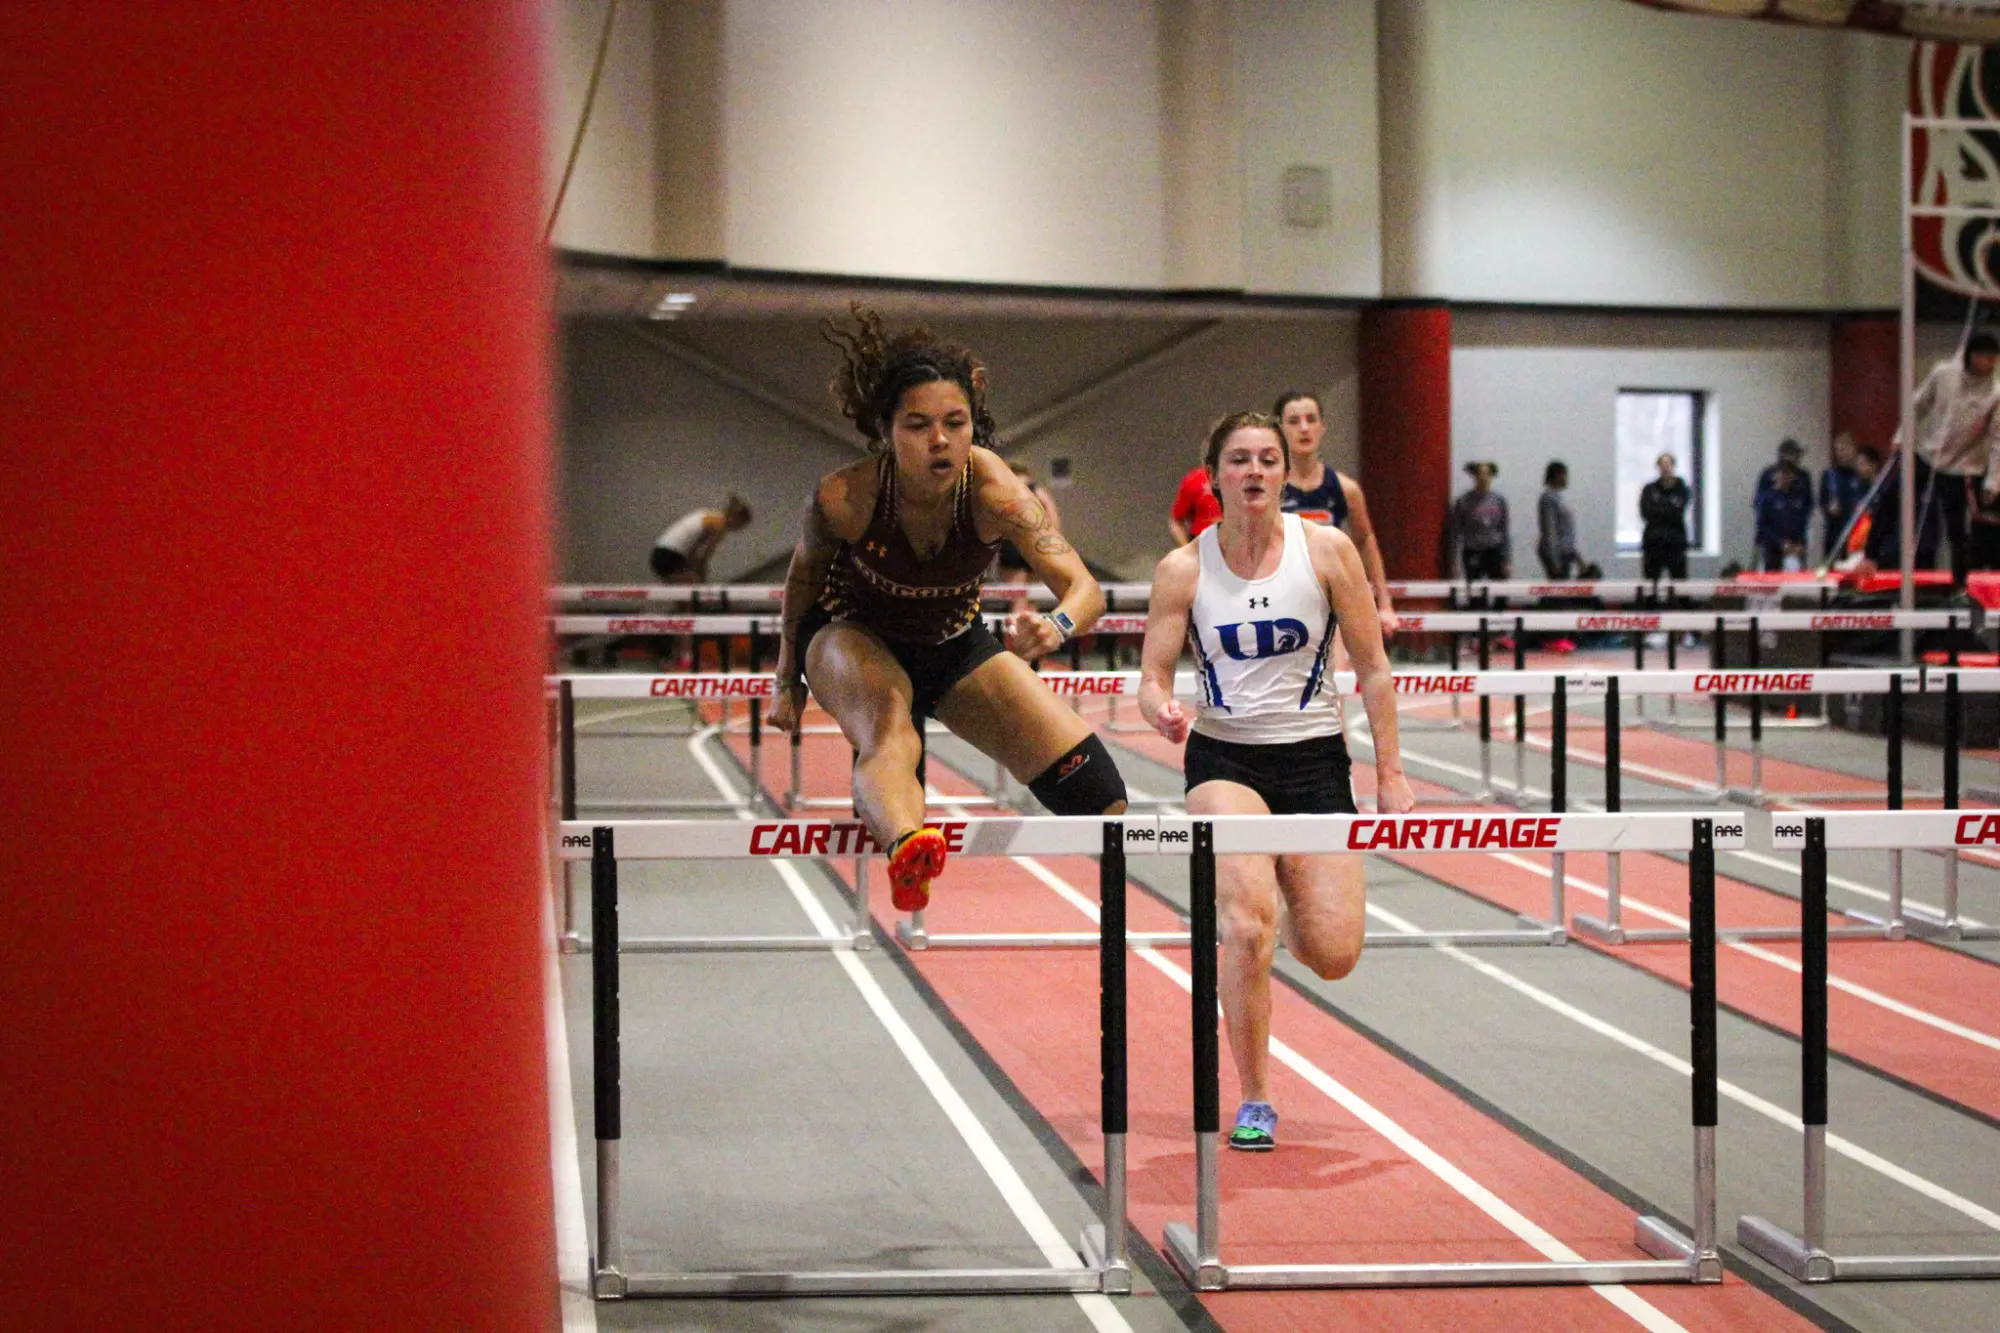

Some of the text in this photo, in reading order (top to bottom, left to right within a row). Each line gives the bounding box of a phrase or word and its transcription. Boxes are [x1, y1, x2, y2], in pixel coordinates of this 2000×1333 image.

[1577, 616, 1661, 630] CARTHAGE
[1811, 615, 1894, 629] CARTHAGE
[1213, 618, 1309, 661] UD
[650, 678, 773, 697] CARTHAGE
[1042, 677, 1126, 694] THAGE
[1694, 674, 1814, 692] CARTHAGE
[749, 822, 967, 855] CARTHE
[1347, 818, 1561, 849] CARTHAGE
